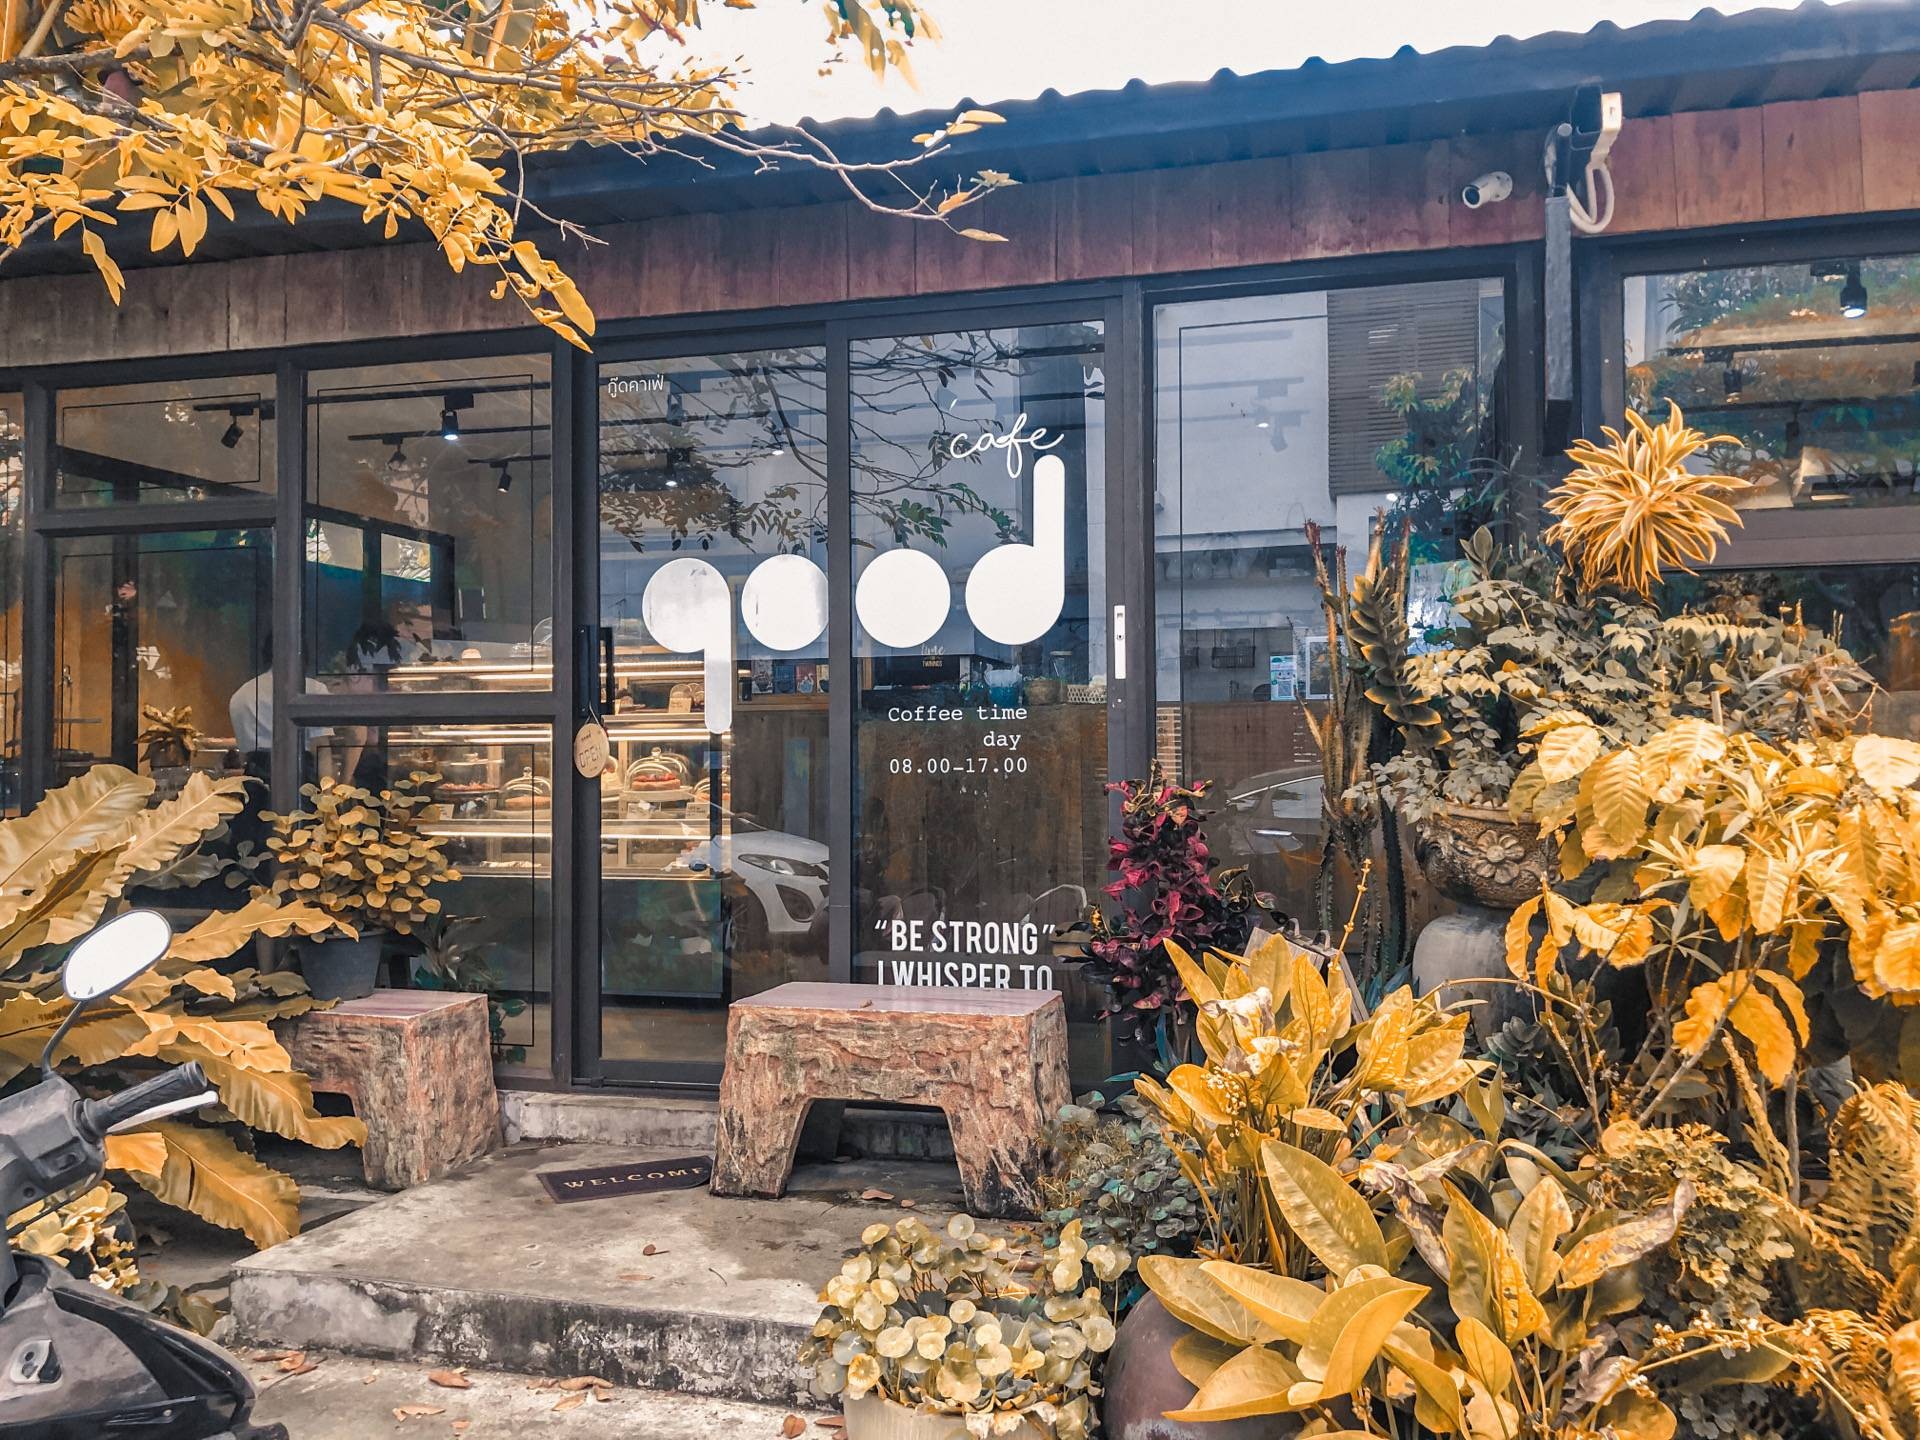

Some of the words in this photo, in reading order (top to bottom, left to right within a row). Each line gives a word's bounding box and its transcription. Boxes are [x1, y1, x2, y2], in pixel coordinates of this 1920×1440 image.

[607, 374, 664, 398] กู๊ดคาเฟ่
[641, 454, 1066, 734] good
[888, 705, 963, 722] Coffee
[976, 703, 1028, 720] time
[983, 730, 1022, 751] day
[877, 960, 884, 985] I
[892, 960, 1011, 990] WHISPER
[1020, 964, 1053, 991] TO
[563, 1167, 704, 1189] WELCOME
